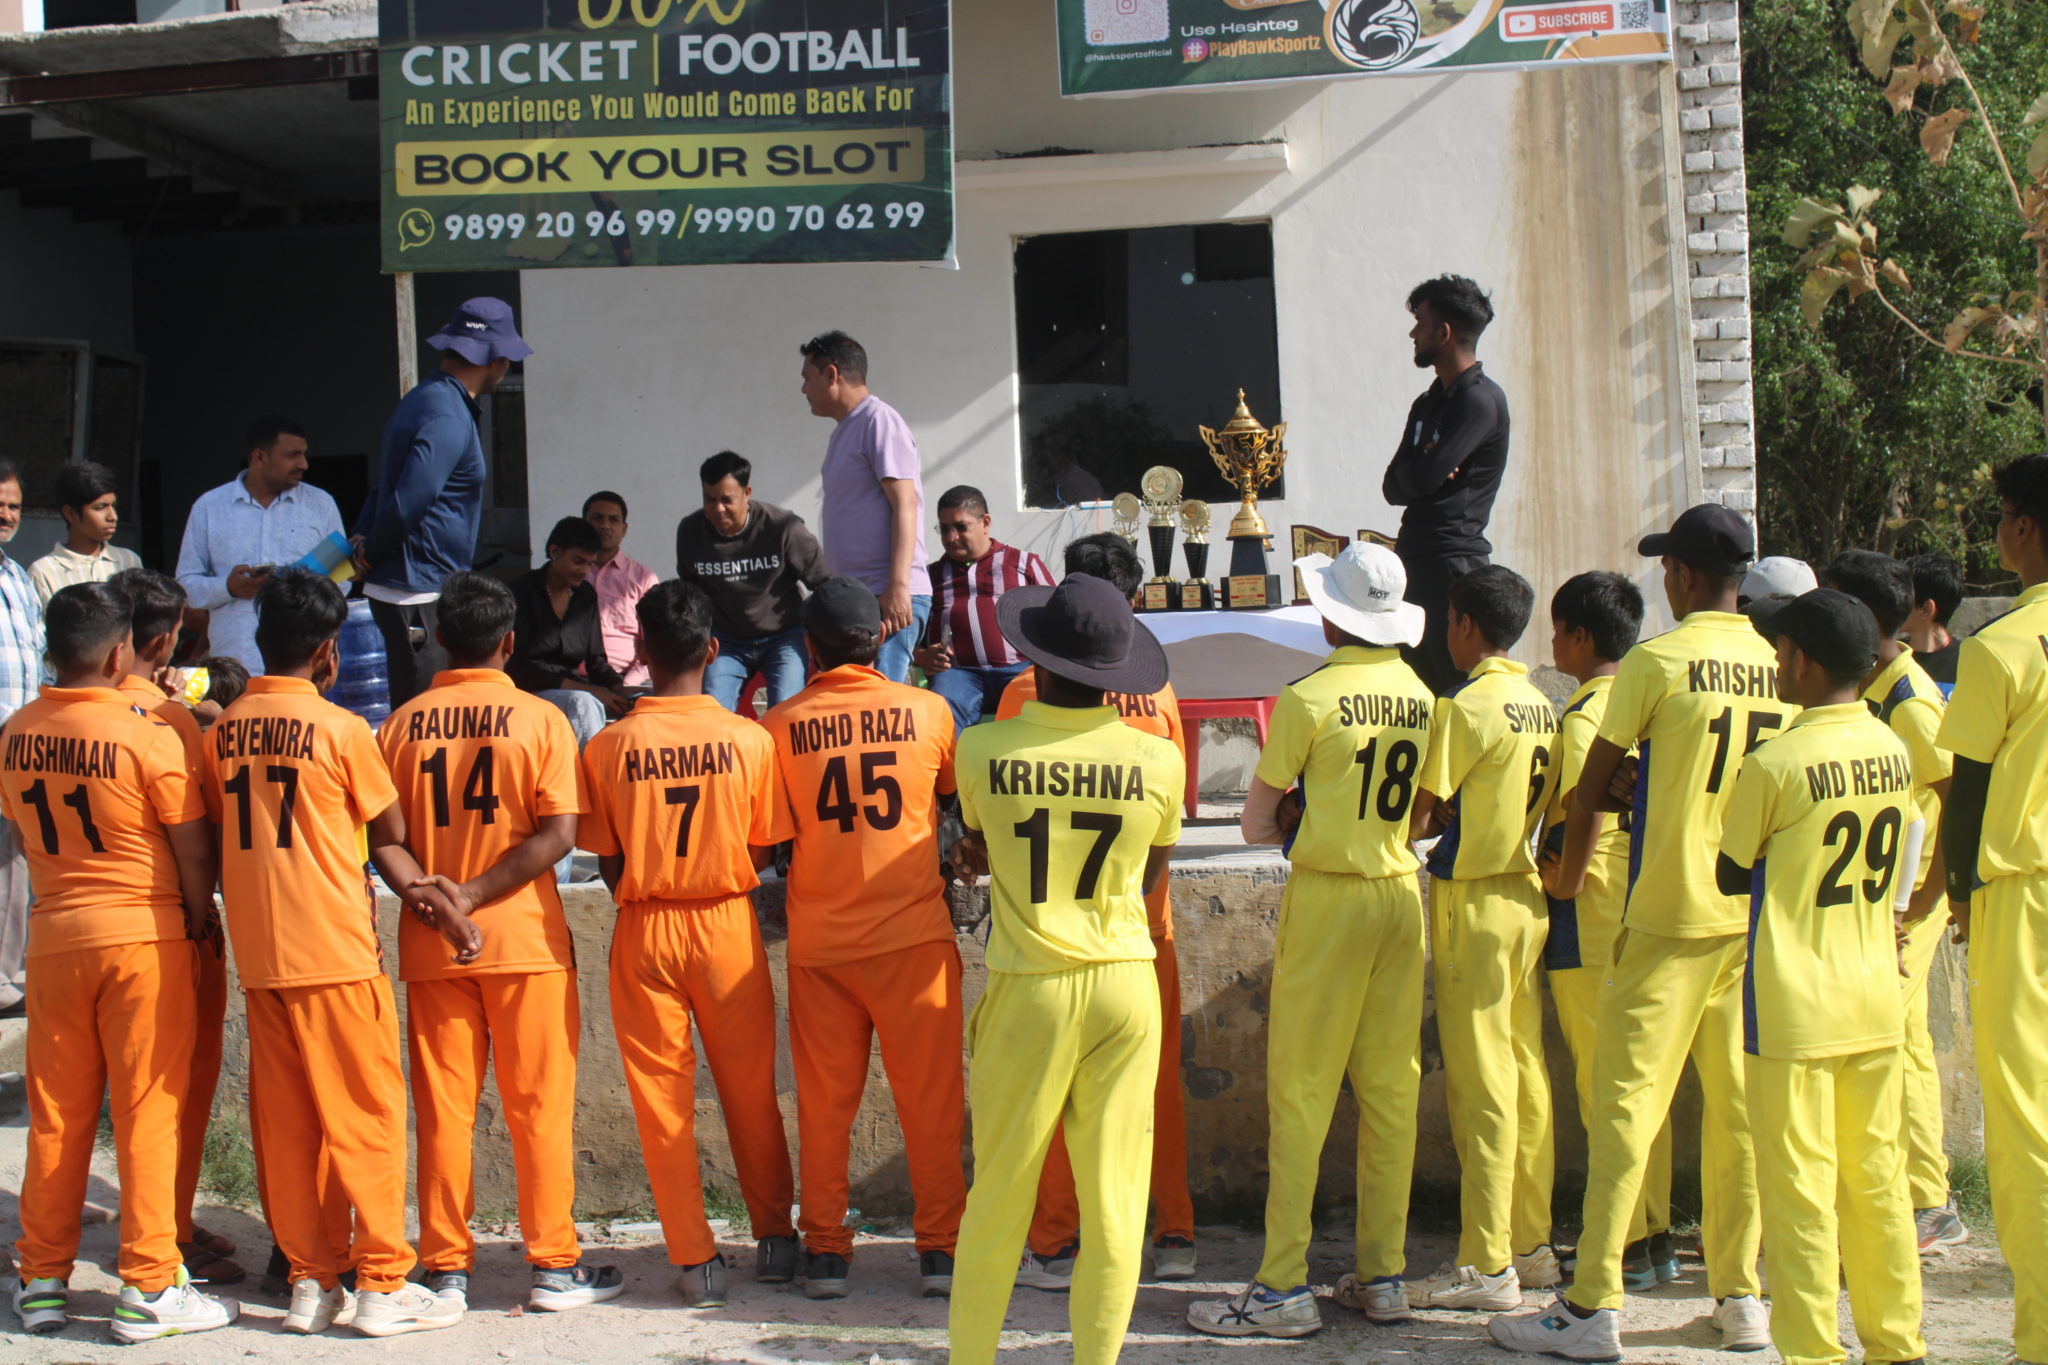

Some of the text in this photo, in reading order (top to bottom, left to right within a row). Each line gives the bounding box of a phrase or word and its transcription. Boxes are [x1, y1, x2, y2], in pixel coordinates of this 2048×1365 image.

[1181, 19, 1298, 36] Use Hashtag
[1539, 11, 1607, 28] SUBSCRIBE
[401, 27, 920, 86] CRICKET FOOTBALL
[1209, 35, 1321, 58] PlayHawkSportz
[405, 85, 914, 127] An Experience You Would Come Back For
[413, 141, 911, 186] BOOK YOUR SLOT
[444, 213, 526, 240] 9899
[536, 211, 575, 238] 20
[585, 210, 626, 237] 96
[786, 205, 825, 231] 70
[835, 203, 875, 230] 62
[884, 201, 925, 229] 99
[1688, 659, 1777, 699] KRISHN
[408, 705, 514, 742] RAUNAK
[1106, 691, 1157, 717] RAG
[1338, 694, 1428, 731] SOURABH
[216, 717, 315, 762] DEVENDRA
[789, 708, 917, 756] MOHD RAZA
[4, 734, 117, 779] AYUSHMAAN
[624, 742, 733, 783] HARMAN
[420, 746, 499, 827] 14
[816, 750, 901, 834] 45
[989, 759, 1145, 801] KRISHNA
[1355, 737, 1419, 822] 18
[1805, 760, 1846, 802] MD
[21, 779, 108, 855] 11
[224, 765, 298, 850] 17
[664, 785, 700, 858] 7
[1014, 807, 1123, 904] 17
[1816, 806, 1901, 908] 29
